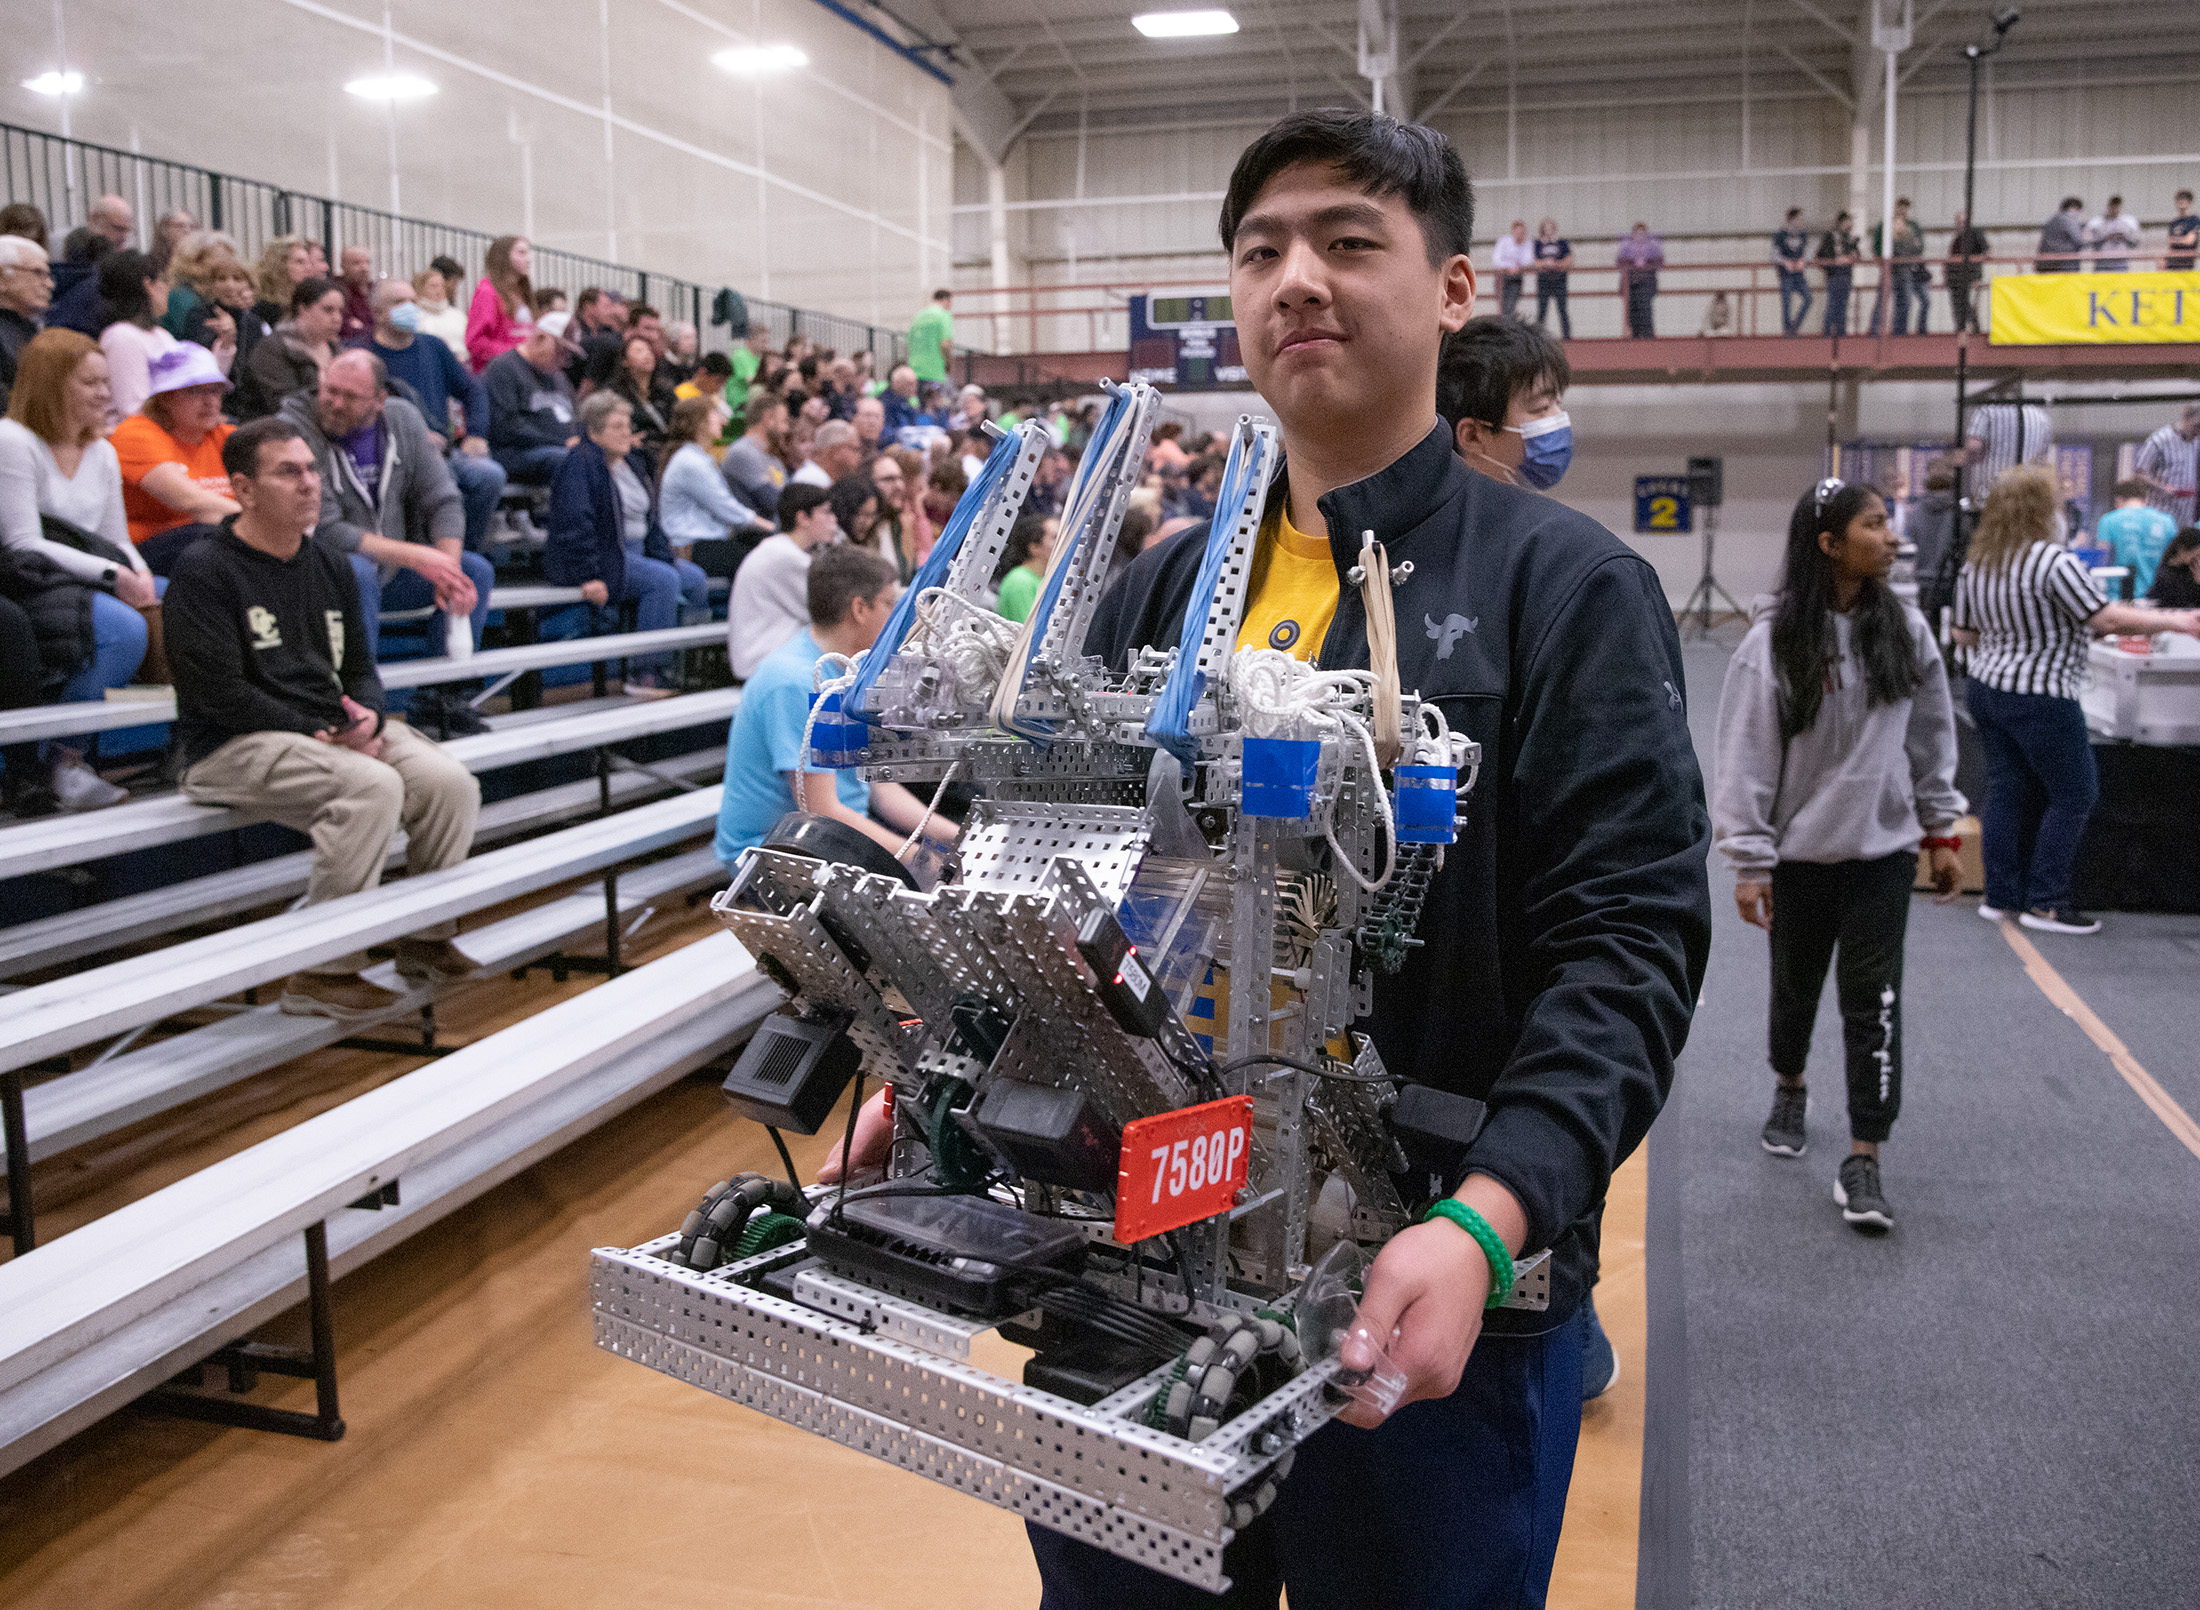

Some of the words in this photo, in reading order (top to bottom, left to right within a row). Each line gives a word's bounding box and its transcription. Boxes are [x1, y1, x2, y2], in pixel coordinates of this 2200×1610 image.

[2088, 288, 2200, 329] KET
[1650, 497, 1677, 527] 2
[1151, 1126, 1244, 1204] 7580P
